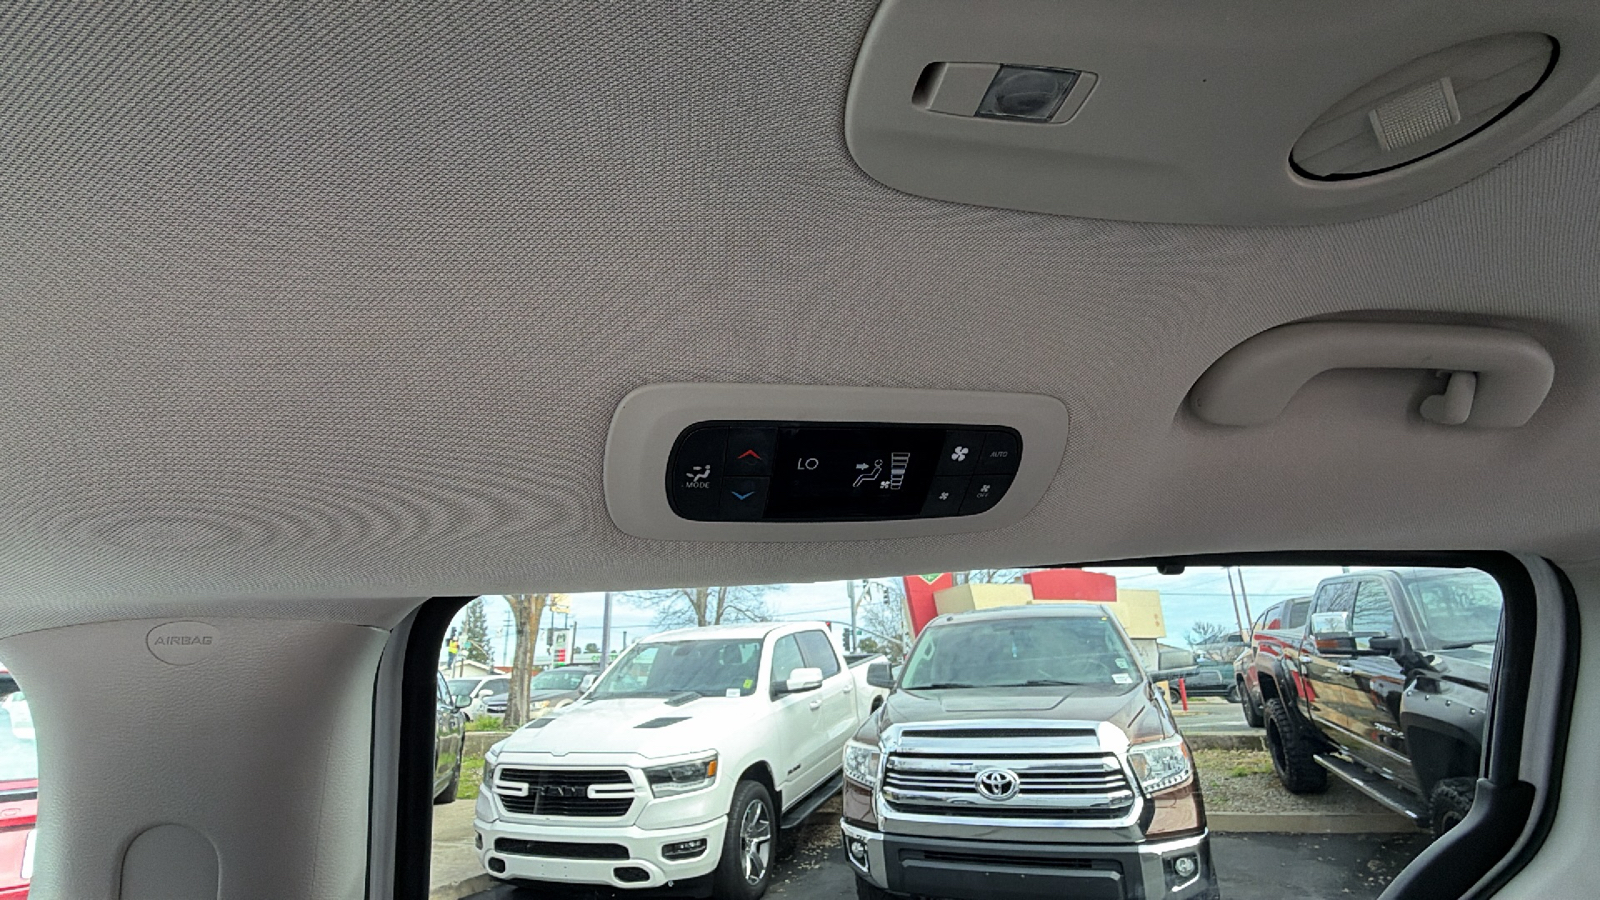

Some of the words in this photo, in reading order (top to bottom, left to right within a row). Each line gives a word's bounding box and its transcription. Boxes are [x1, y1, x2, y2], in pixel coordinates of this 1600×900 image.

[797, 458, 819, 470] LO
[685, 481, 710, 489] MODE
[154, 636, 213, 645] AIRBAG
